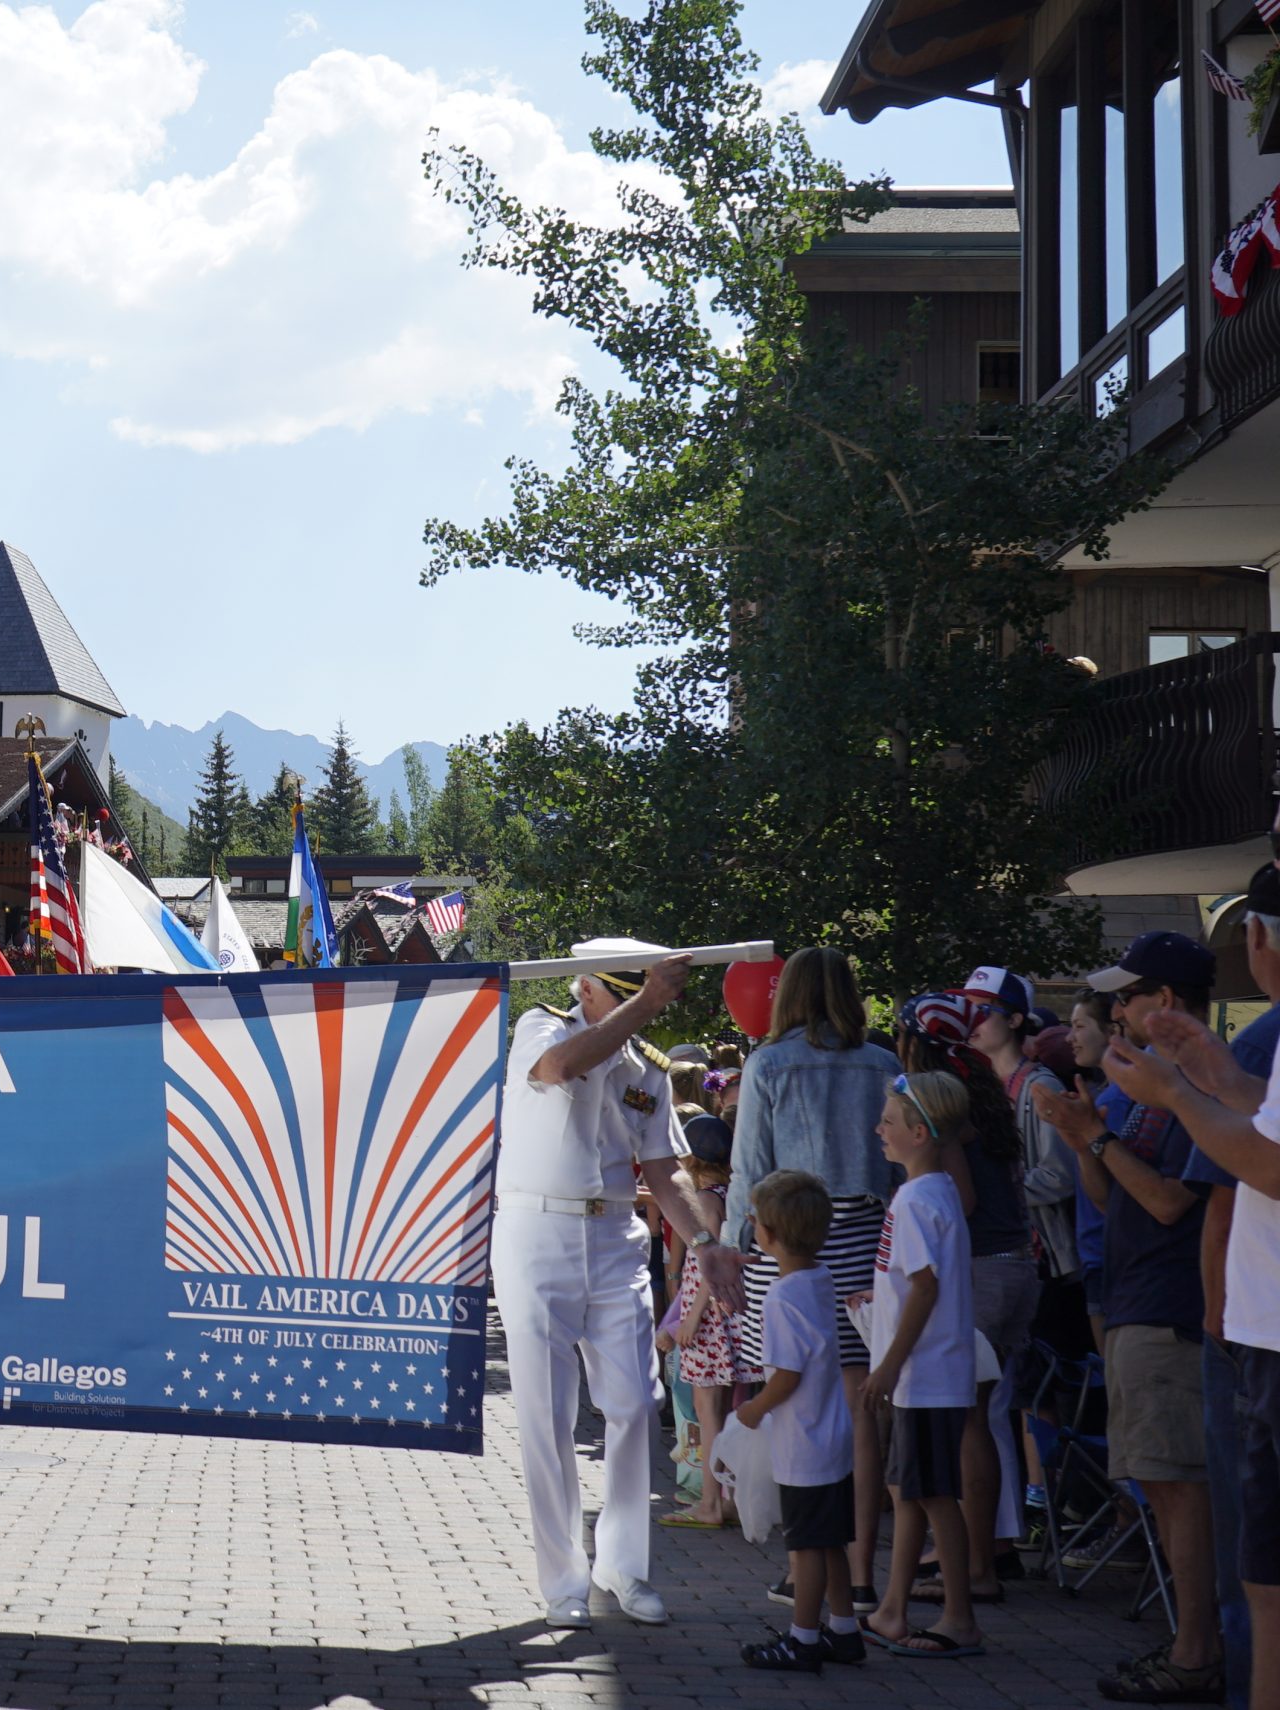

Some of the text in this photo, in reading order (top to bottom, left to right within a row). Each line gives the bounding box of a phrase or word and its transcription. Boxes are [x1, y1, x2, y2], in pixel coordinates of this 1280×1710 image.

[182, 1282, 248, 1310] VAIL
[257, 1285, 387, 1317] AMERICA
[248, 1329, 269, 1345] OF
[274, 1331, 317, 1348] JULY
[1, 1355, 127, 1389] Gallegos
[53, 1391, 126, 1404] Building Solutions
[92, 1405, 125, 1417] Projects
